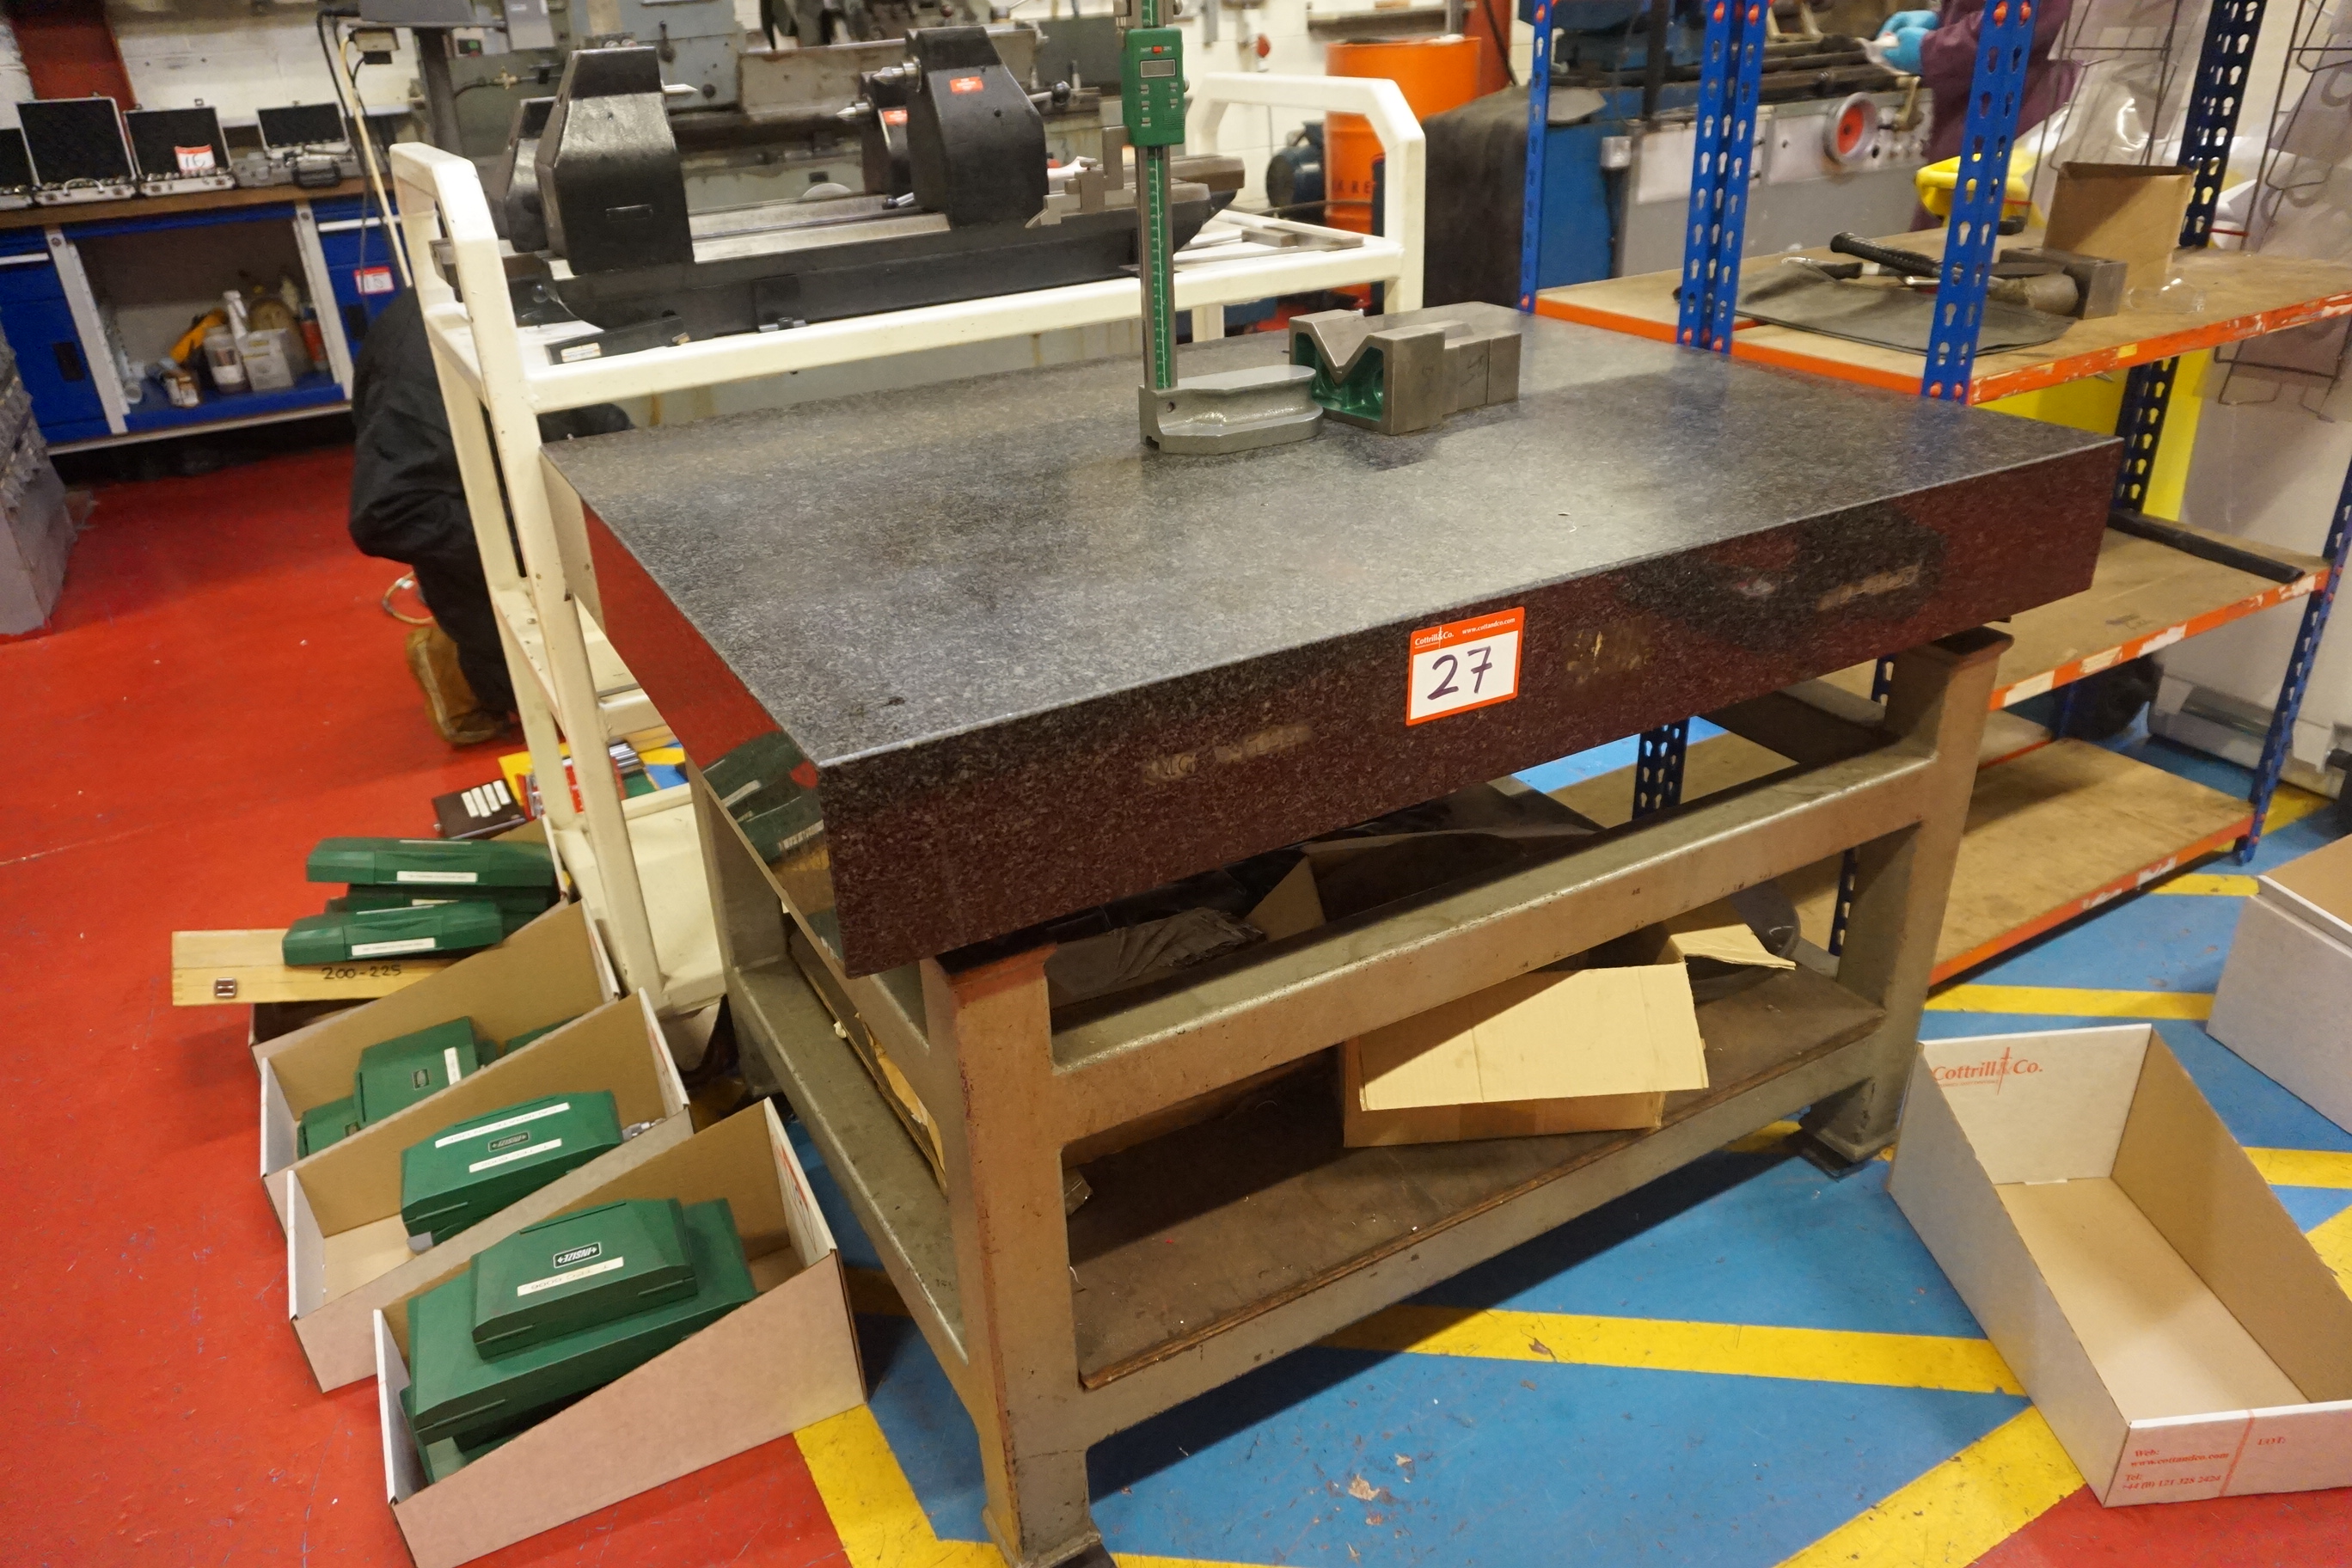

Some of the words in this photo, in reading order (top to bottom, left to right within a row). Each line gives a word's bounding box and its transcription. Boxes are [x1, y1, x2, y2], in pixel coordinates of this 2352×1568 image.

[1427, 646, 1493, 700] 27
[321, 965, 401, 979] 200-225
[562, 1246, 595, 1264] INSIZE
